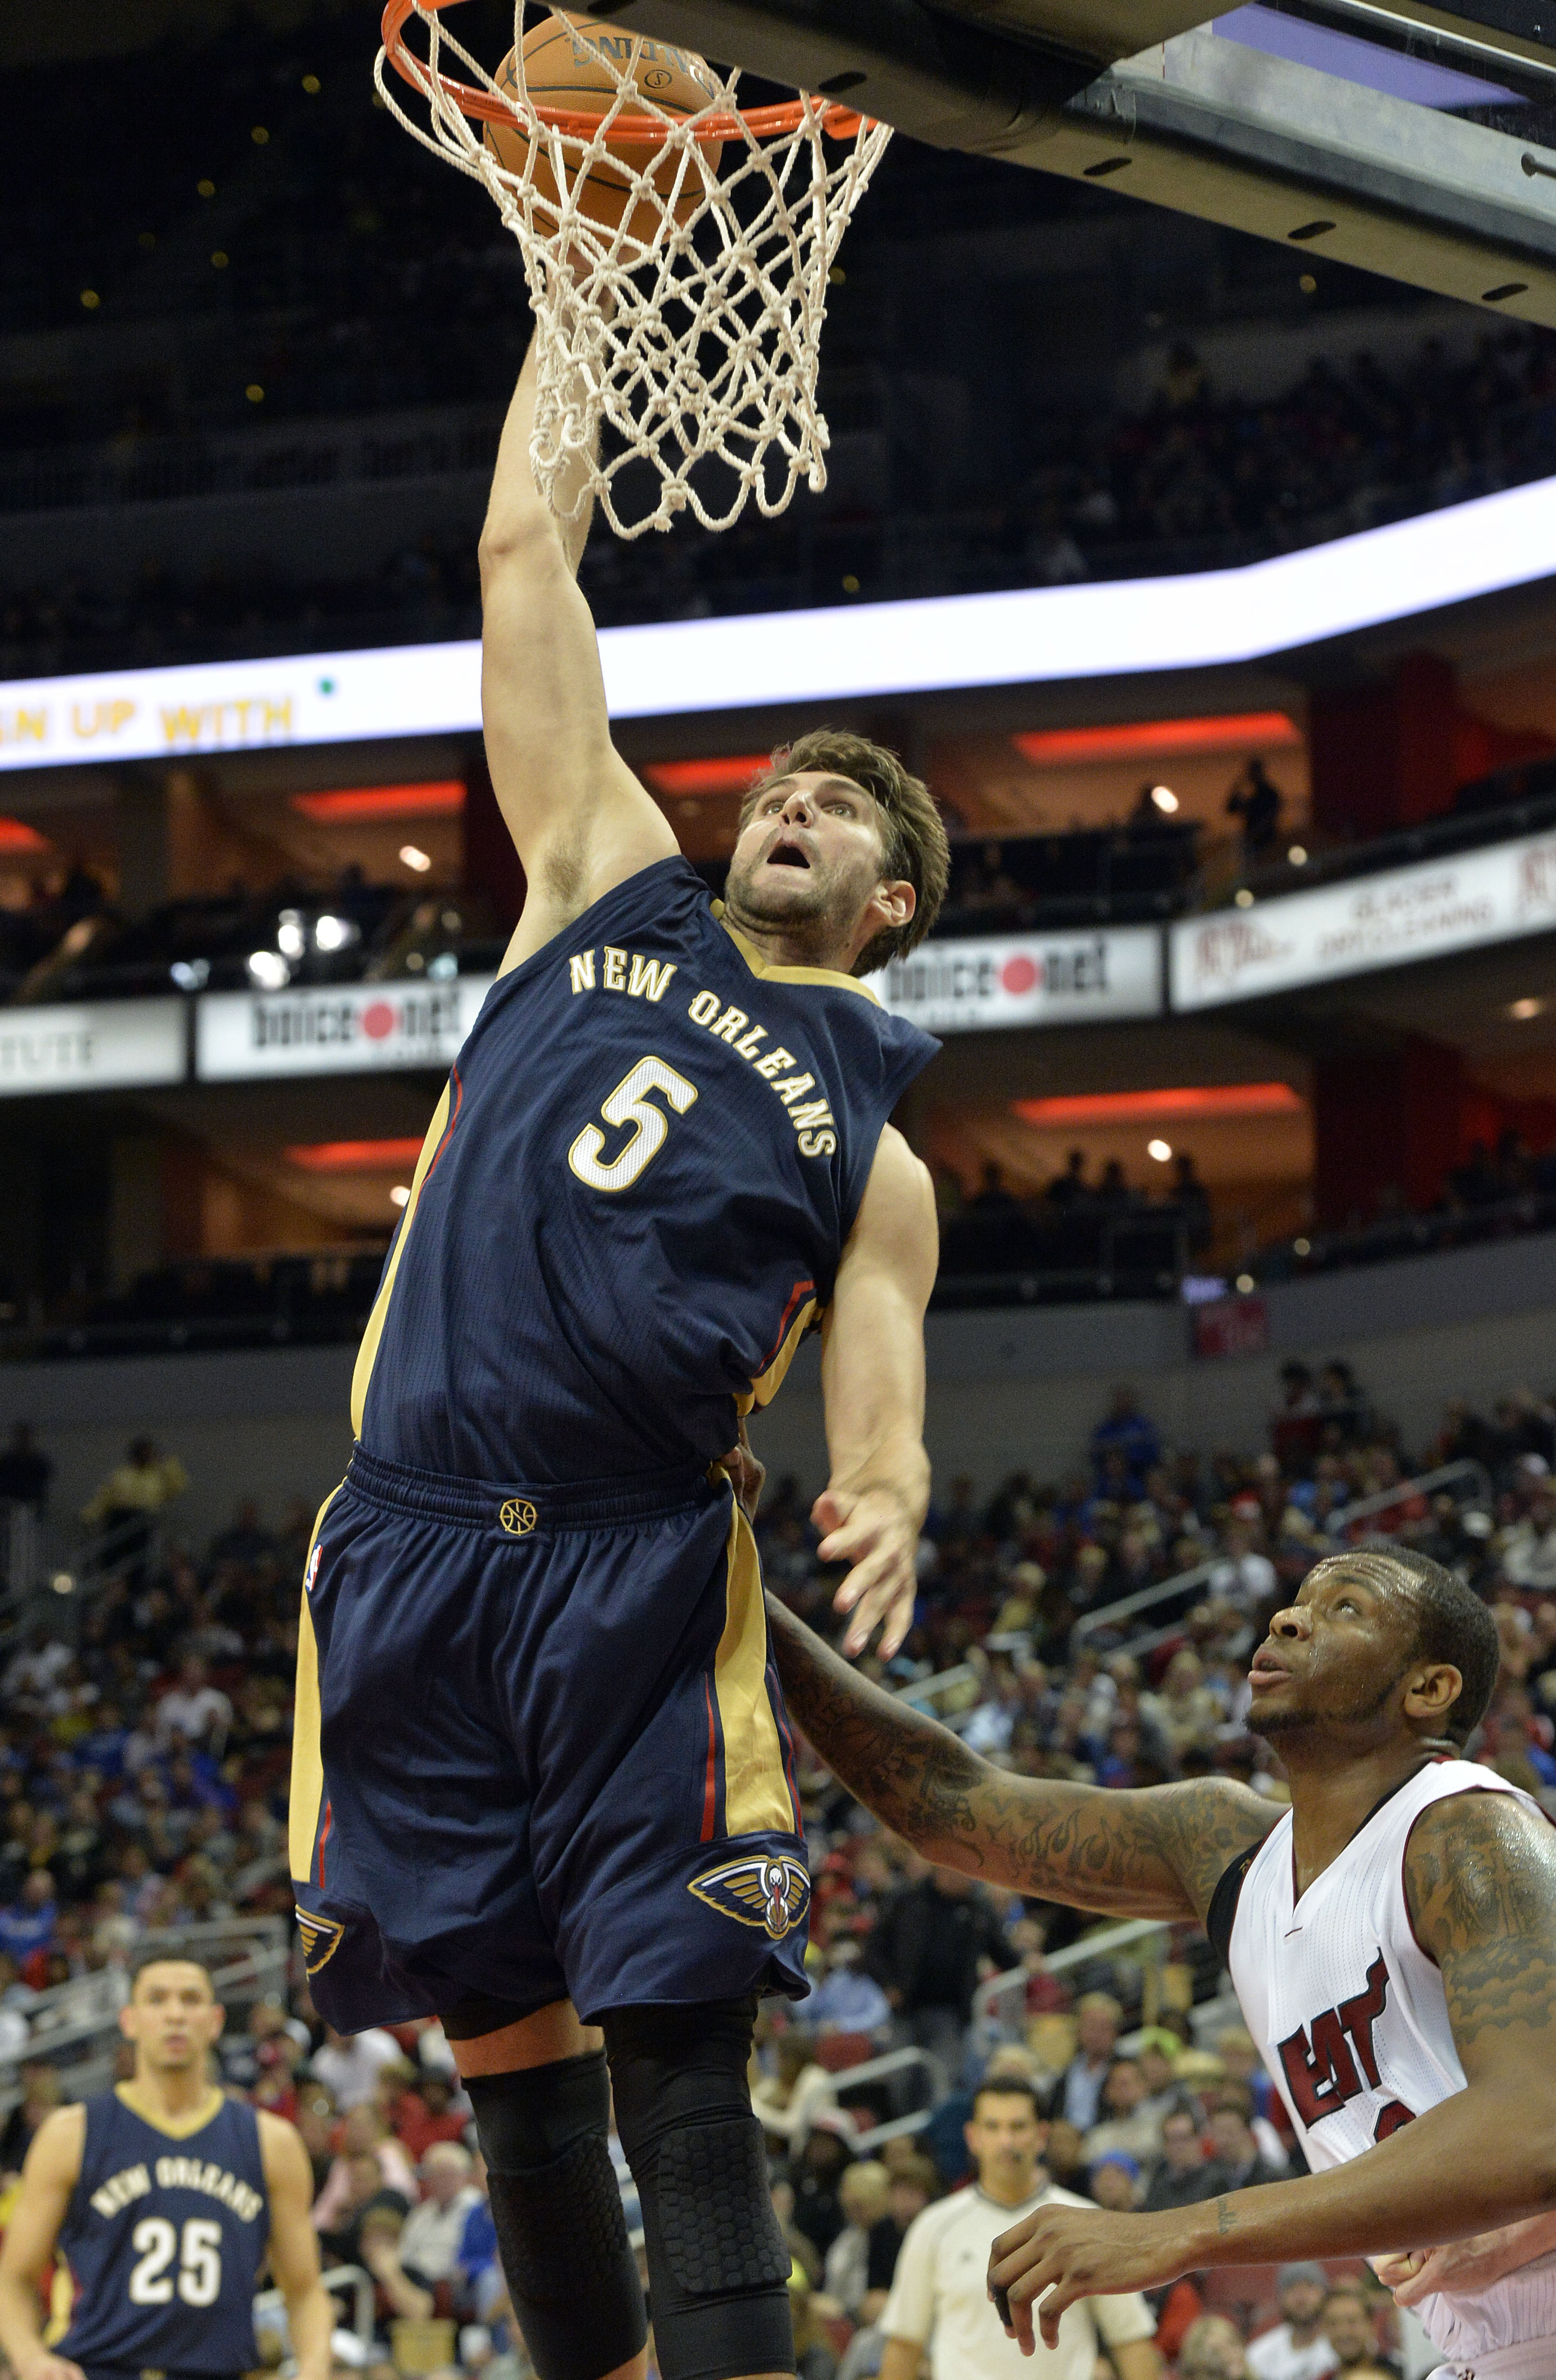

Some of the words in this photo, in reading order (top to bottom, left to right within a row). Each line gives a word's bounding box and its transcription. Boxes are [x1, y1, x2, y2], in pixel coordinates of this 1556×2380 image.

[70, 699, 137, 739] UP
[160, 695, 294, 743] WITH
[569, 945, 677, 1002] NEW
[688, 990, 837, 1157] ORLEANS
[568, 1055, 698, 1193] 5
[90, 2162, 152, 2219] NEW
[155, 2155, 264, 2224] ORLEANS
[129, 2217, 223, 2307] 25
